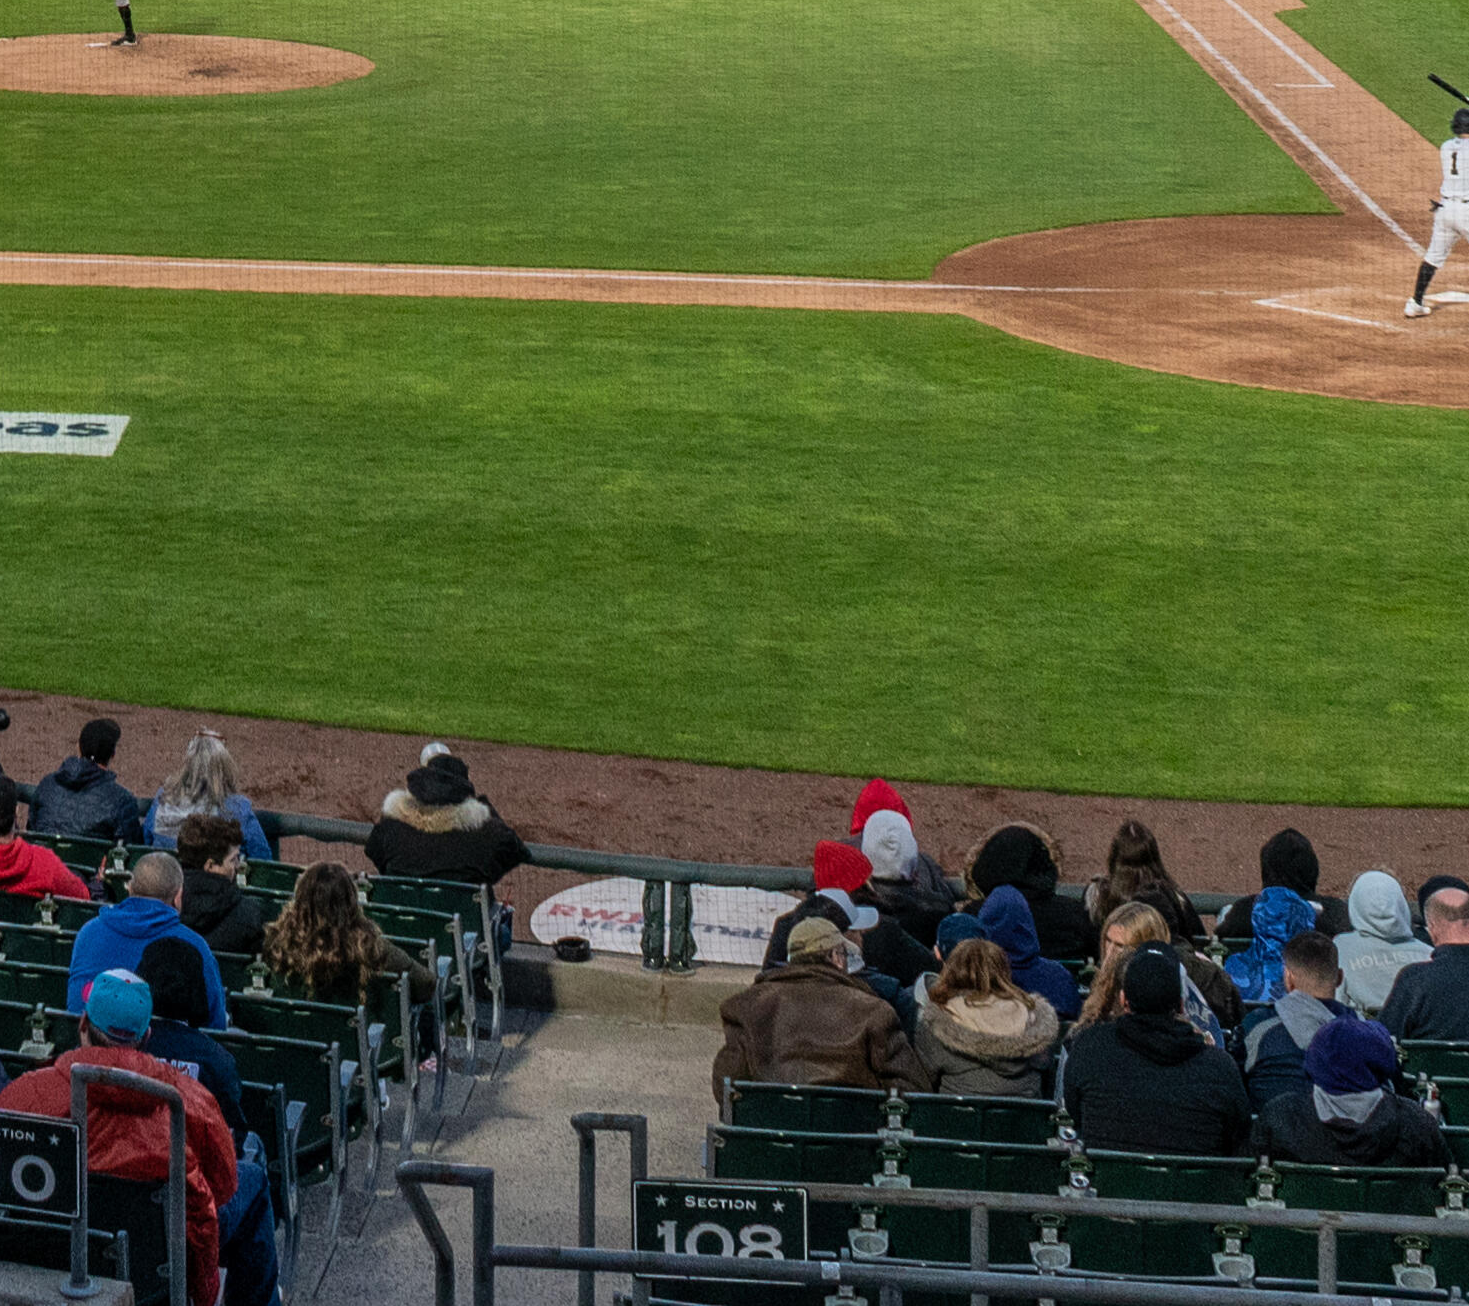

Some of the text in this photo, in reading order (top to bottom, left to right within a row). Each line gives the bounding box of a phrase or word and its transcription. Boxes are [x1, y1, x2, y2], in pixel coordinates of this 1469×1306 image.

[1451, 152, 1458, 175] 1
[684, 1194, 757, 1212] SECTION
[657, 1220, 785, 1261] 108
